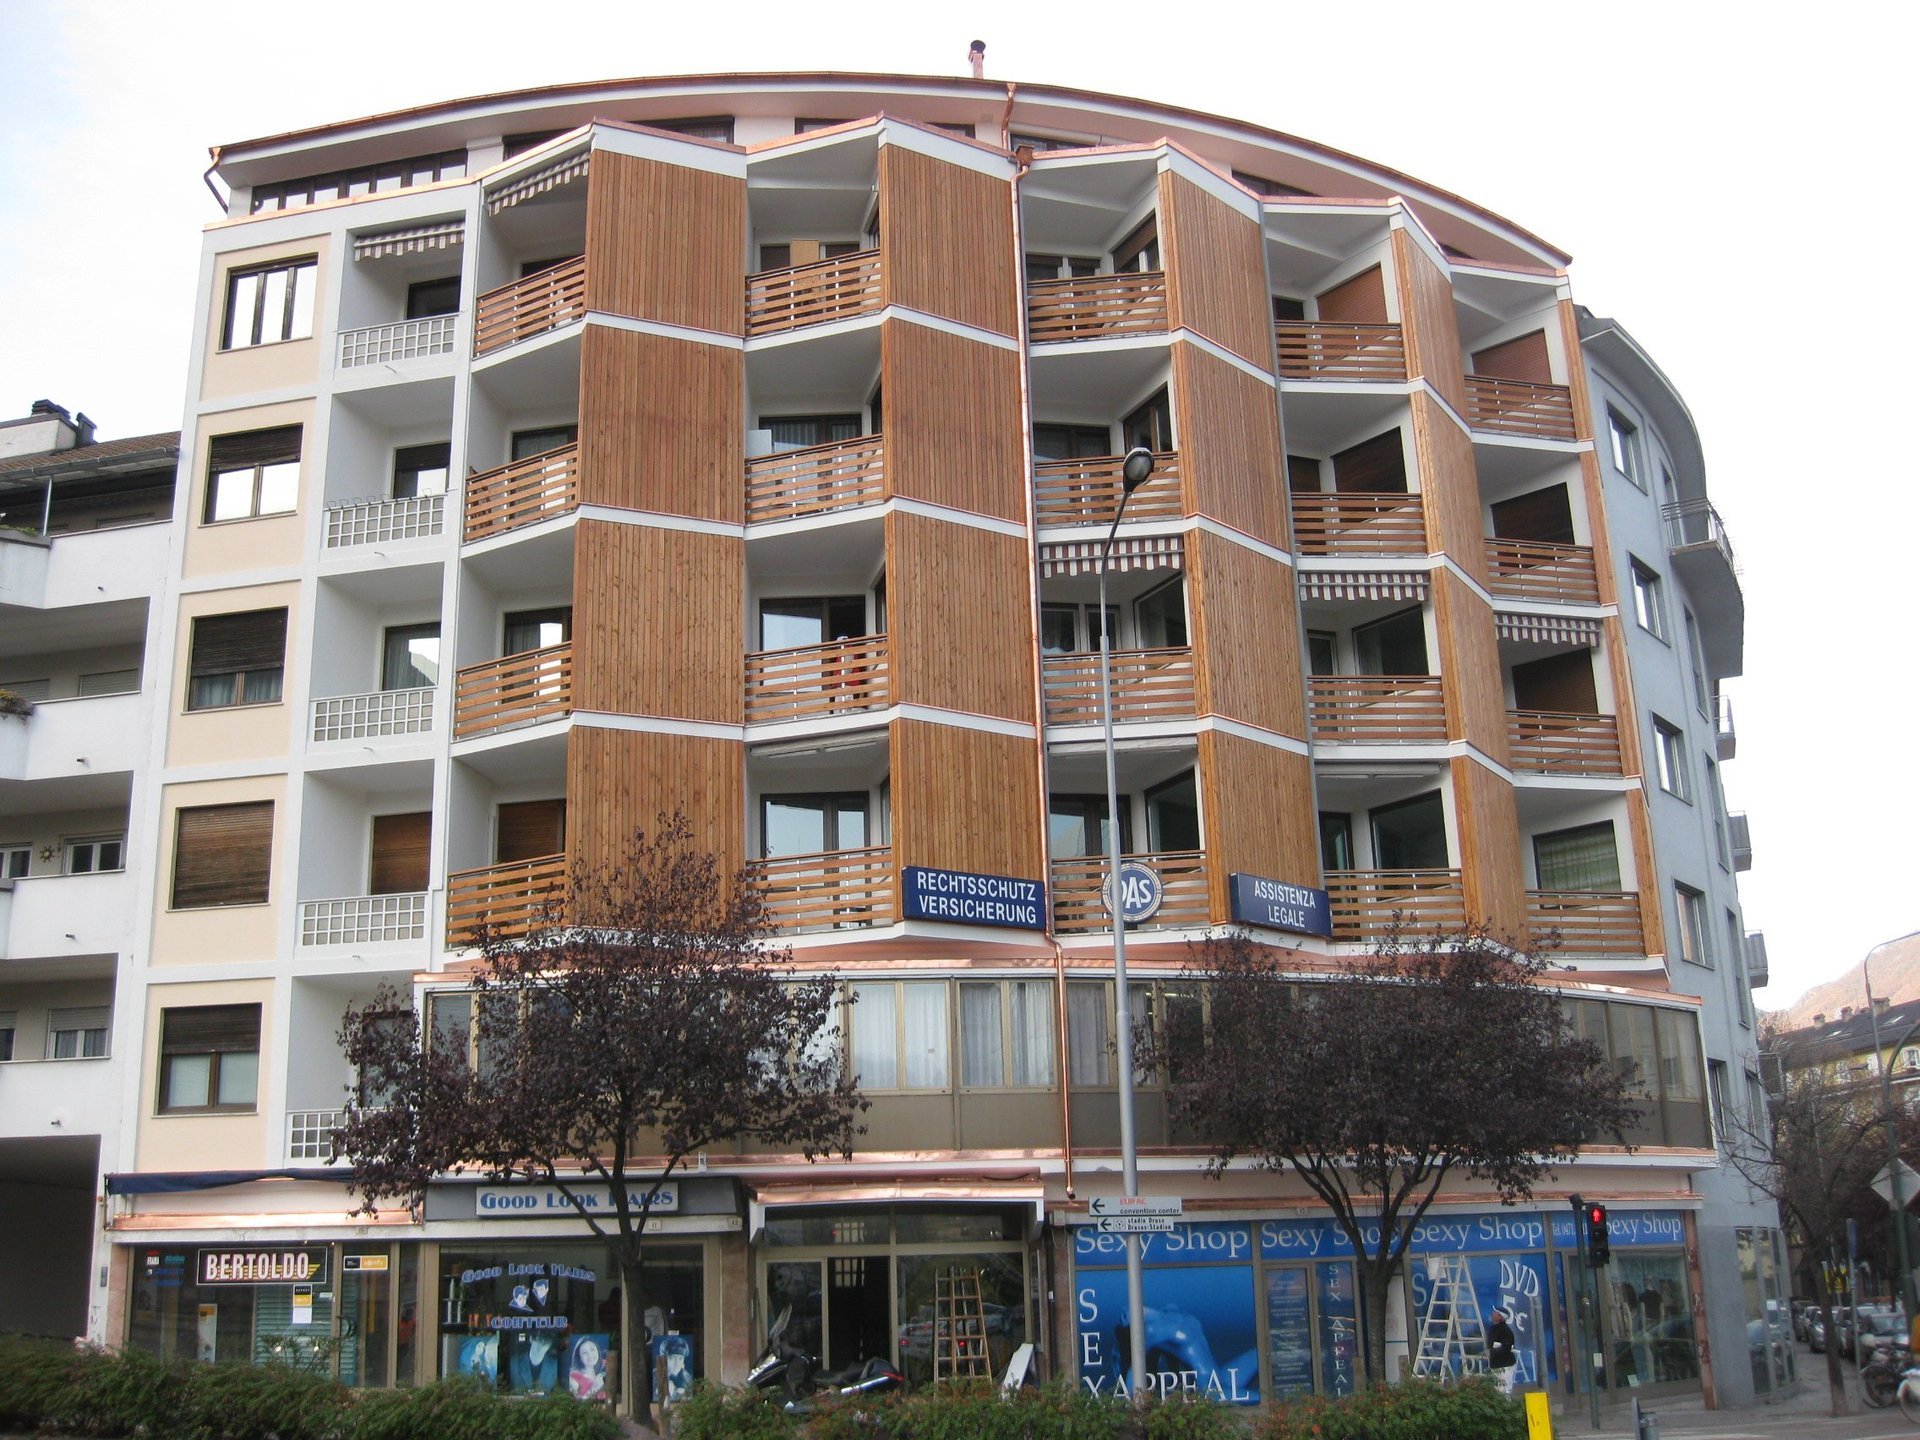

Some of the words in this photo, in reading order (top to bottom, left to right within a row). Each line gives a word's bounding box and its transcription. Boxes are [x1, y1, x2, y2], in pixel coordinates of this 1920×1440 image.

[917, 871, 1036, 901] RECHTSSCHUTZ
[1254, 880, 1316, 909] ASSISTENZA
[918, 895, 1036, 924] VERSICHERUNG
[1268, 904, 1305, 928] LEGALE
[480, 1191, 537, 1209] GOOD
[1120, 1207, 1157, 1215] convention
[1262, 1221, 1324, 1255] Sexy
[1411, 1217, 1471, 1250] Sexy
[1479, 1215, 1543, 1247] Shop
[1642, 1212, 1681, 1241] Shop
[1076, 1226, 1155, 1260] Sexy
[1165, 1224, 1248, 1258] Shop
[206, 1252, 309, 1279] BERTOLDO
[1499, 1258, 1539, 1297] DVD
